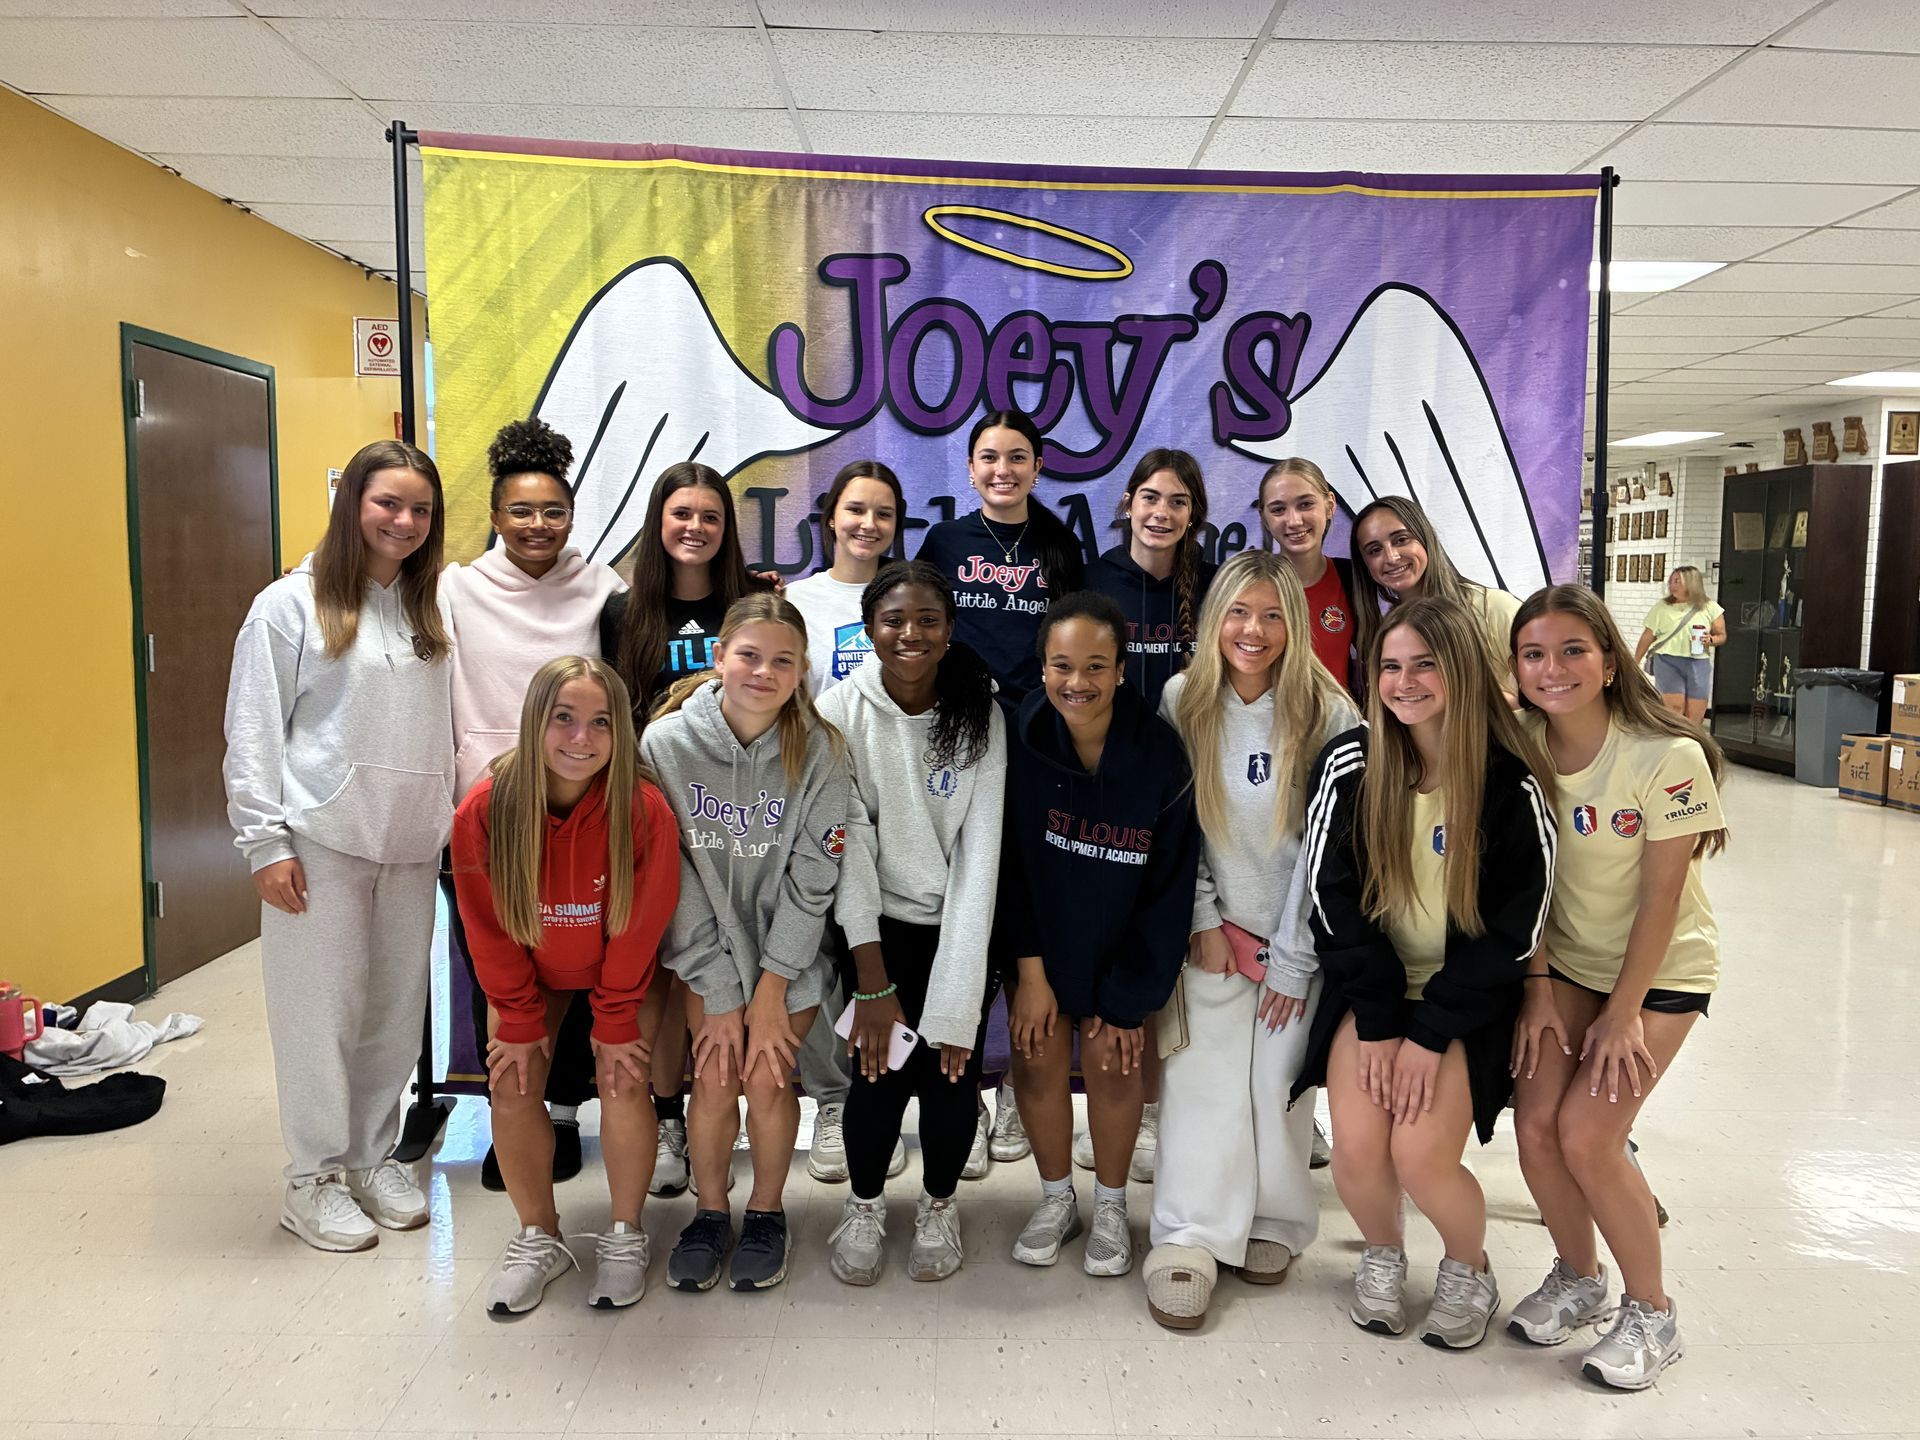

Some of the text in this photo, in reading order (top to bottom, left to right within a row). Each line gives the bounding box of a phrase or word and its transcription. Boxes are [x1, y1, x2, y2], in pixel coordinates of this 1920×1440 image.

[768, 252, 1313, 480] Joey's
[952, 591, 997, 609] Little
[838, 653, 865, 662] WINTE
[688, 782, 785, 838] Joey's
[1664, 802, 1708, 820] TRILOGY
[1079, 818, 1153, 851] LOUIS
[555, 902, 602, 916] SUMME
